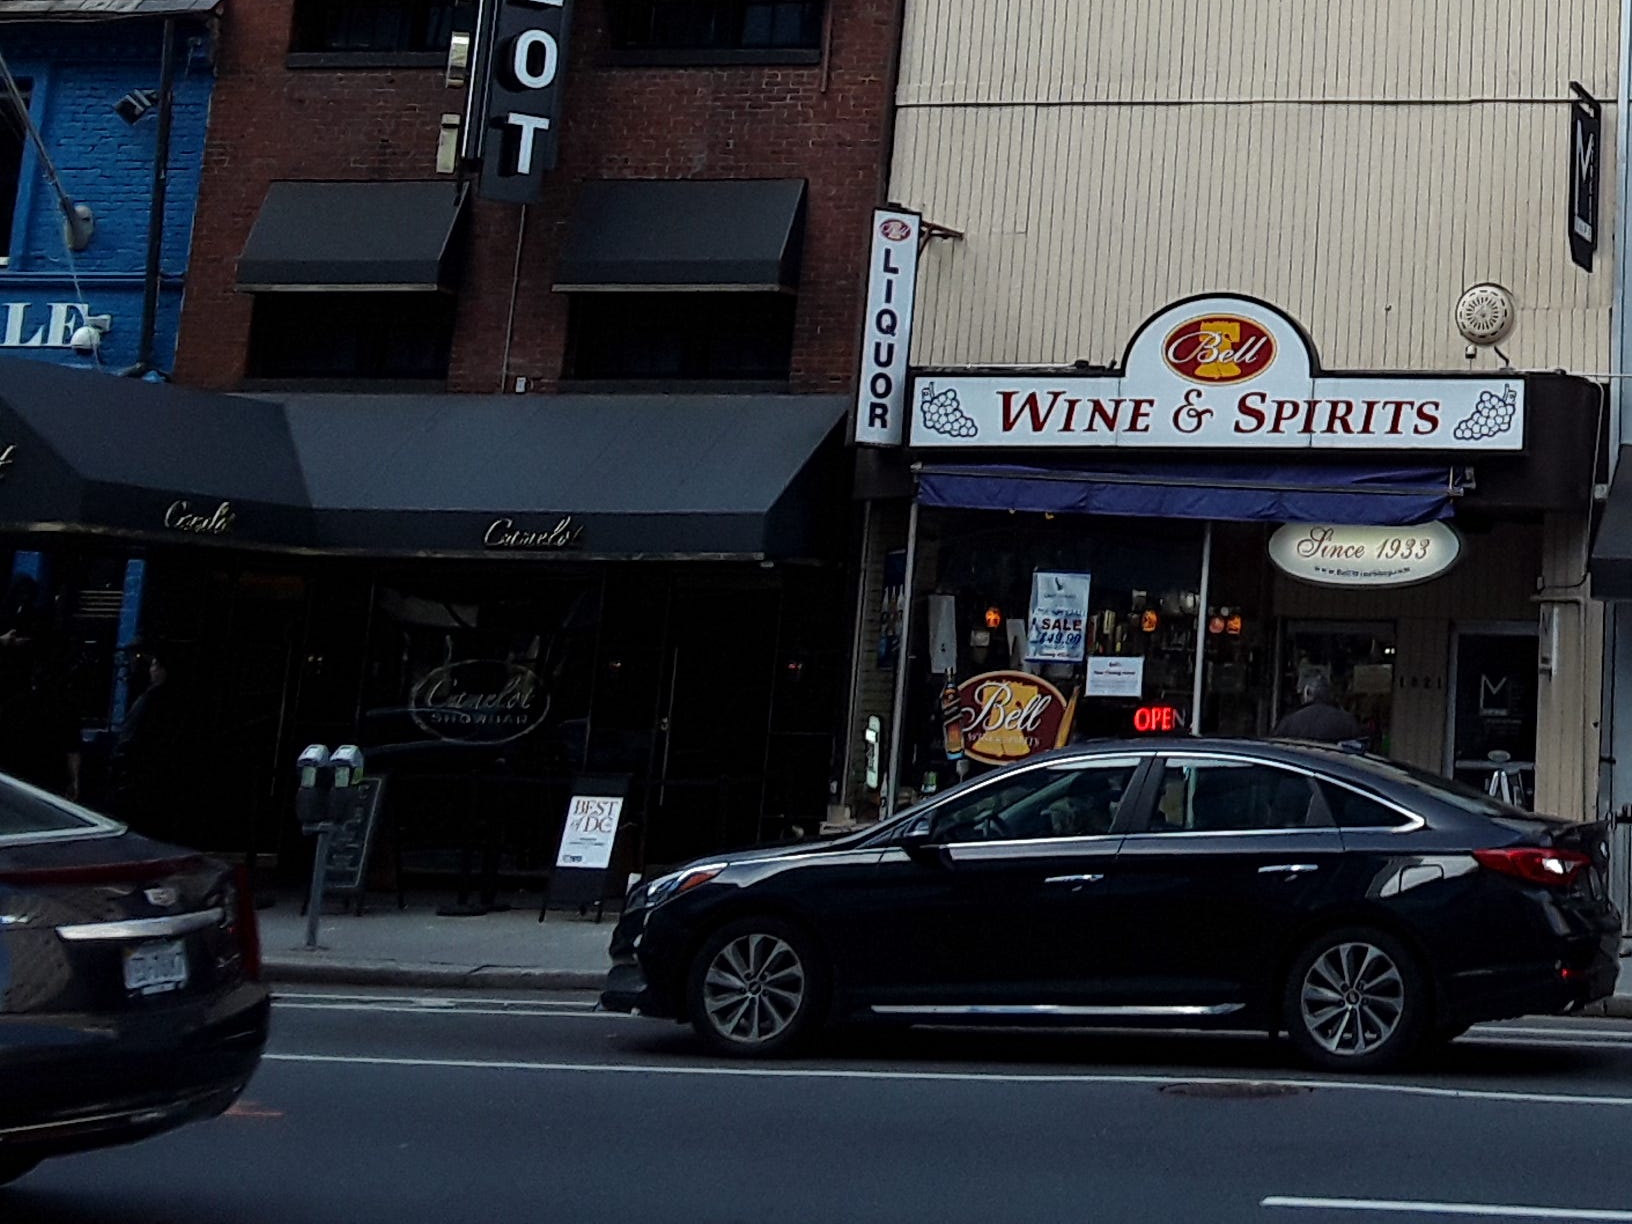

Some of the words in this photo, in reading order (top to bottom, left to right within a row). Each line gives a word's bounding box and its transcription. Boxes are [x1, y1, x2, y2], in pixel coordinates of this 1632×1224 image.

[868, 247, 899, 429] LIQUOR
[1167, 331, 1267, 364] Bell
[996, 389, 1155, 433] WINE
[1172, 388, 1213, 433] &
[1234, 391, 1441, 435] SPIRITS
[1297, 526, 1365, 558] Since
[1376, 537, 1430, 560] 1933
[1041, 618, 1083, 632] SALE
[961, 681, 1052, 732] Bell
[1134, 706, 1186, 732] OPEN
[574, 799, 619, 818] BEST
[583, 816, 614, 834] DC
